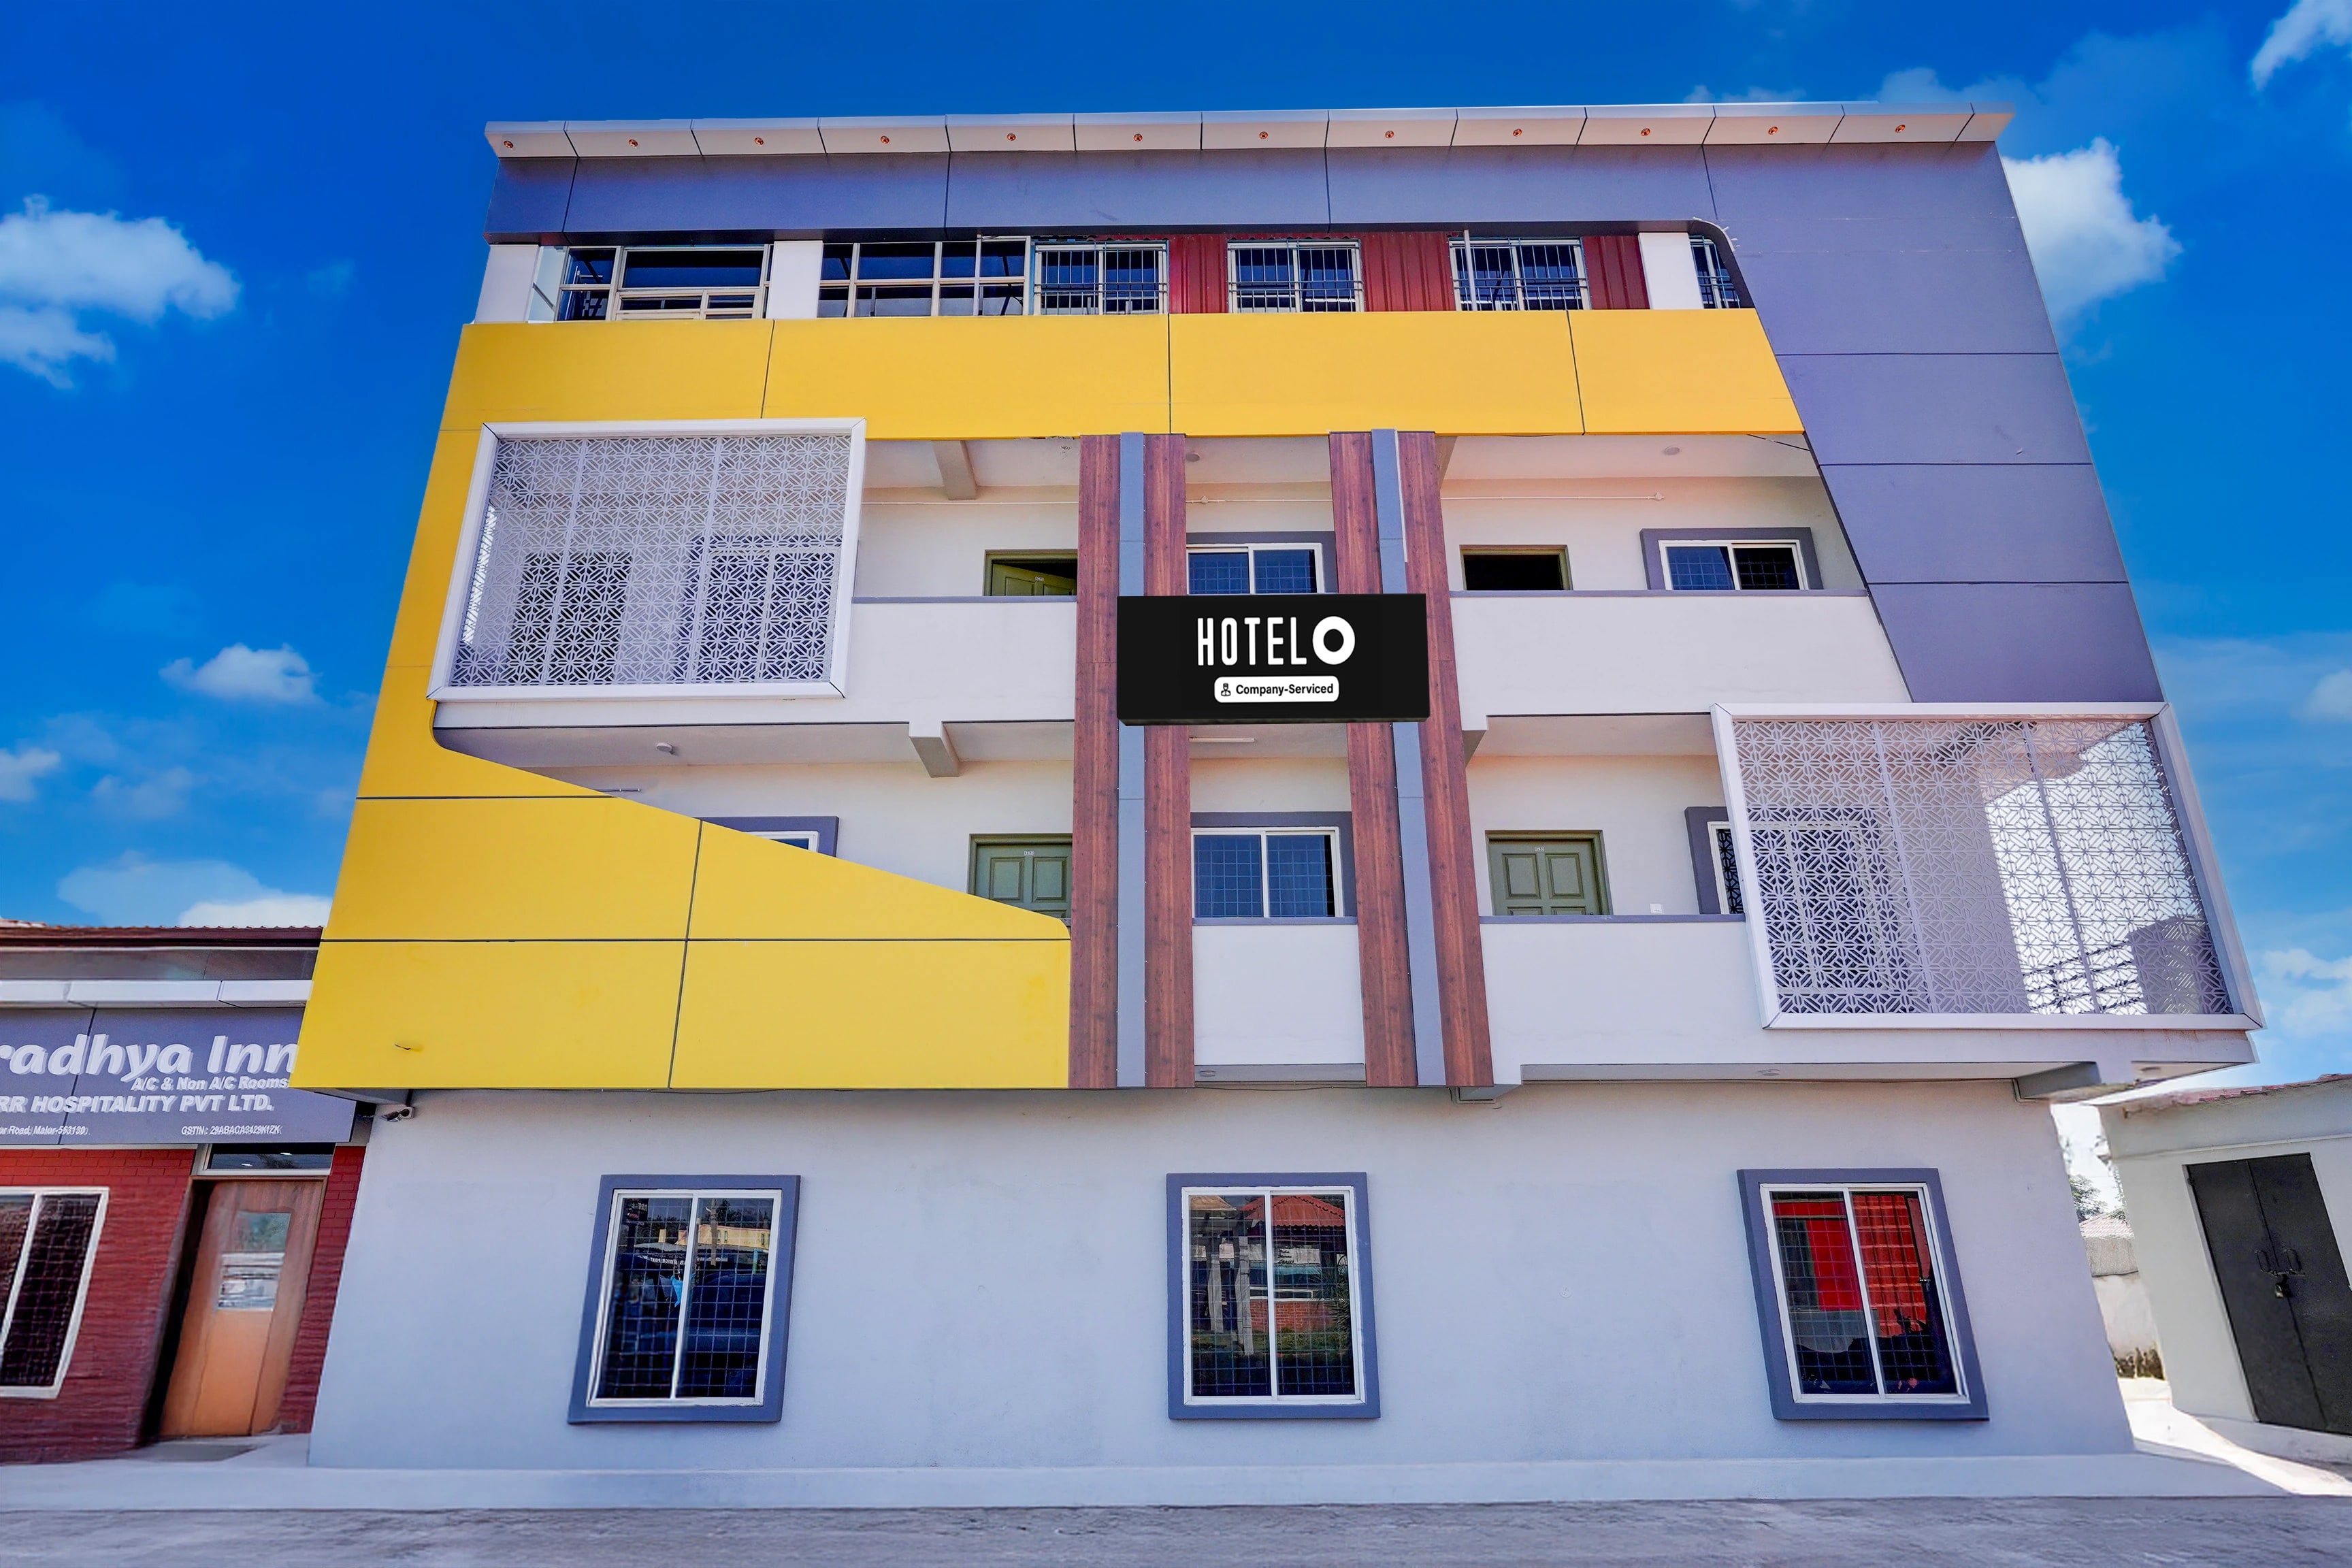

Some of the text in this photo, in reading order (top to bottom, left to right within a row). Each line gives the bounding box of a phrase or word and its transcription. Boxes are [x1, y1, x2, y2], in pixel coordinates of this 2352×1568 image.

[1198, 617, 1307, 666] HOTEL
[1236, 683, 1334, 697] Company-Serviced
[207, 1035, 299, 1074] Inn
[131, 1075, 289, 1091] A/C & Non A/C Rooms
[30, 1095, 178, 1113] HOSPITALITY
[179, 1094, 226, 1112] PVT
[228, 1094, 274, 1111] LTD.
